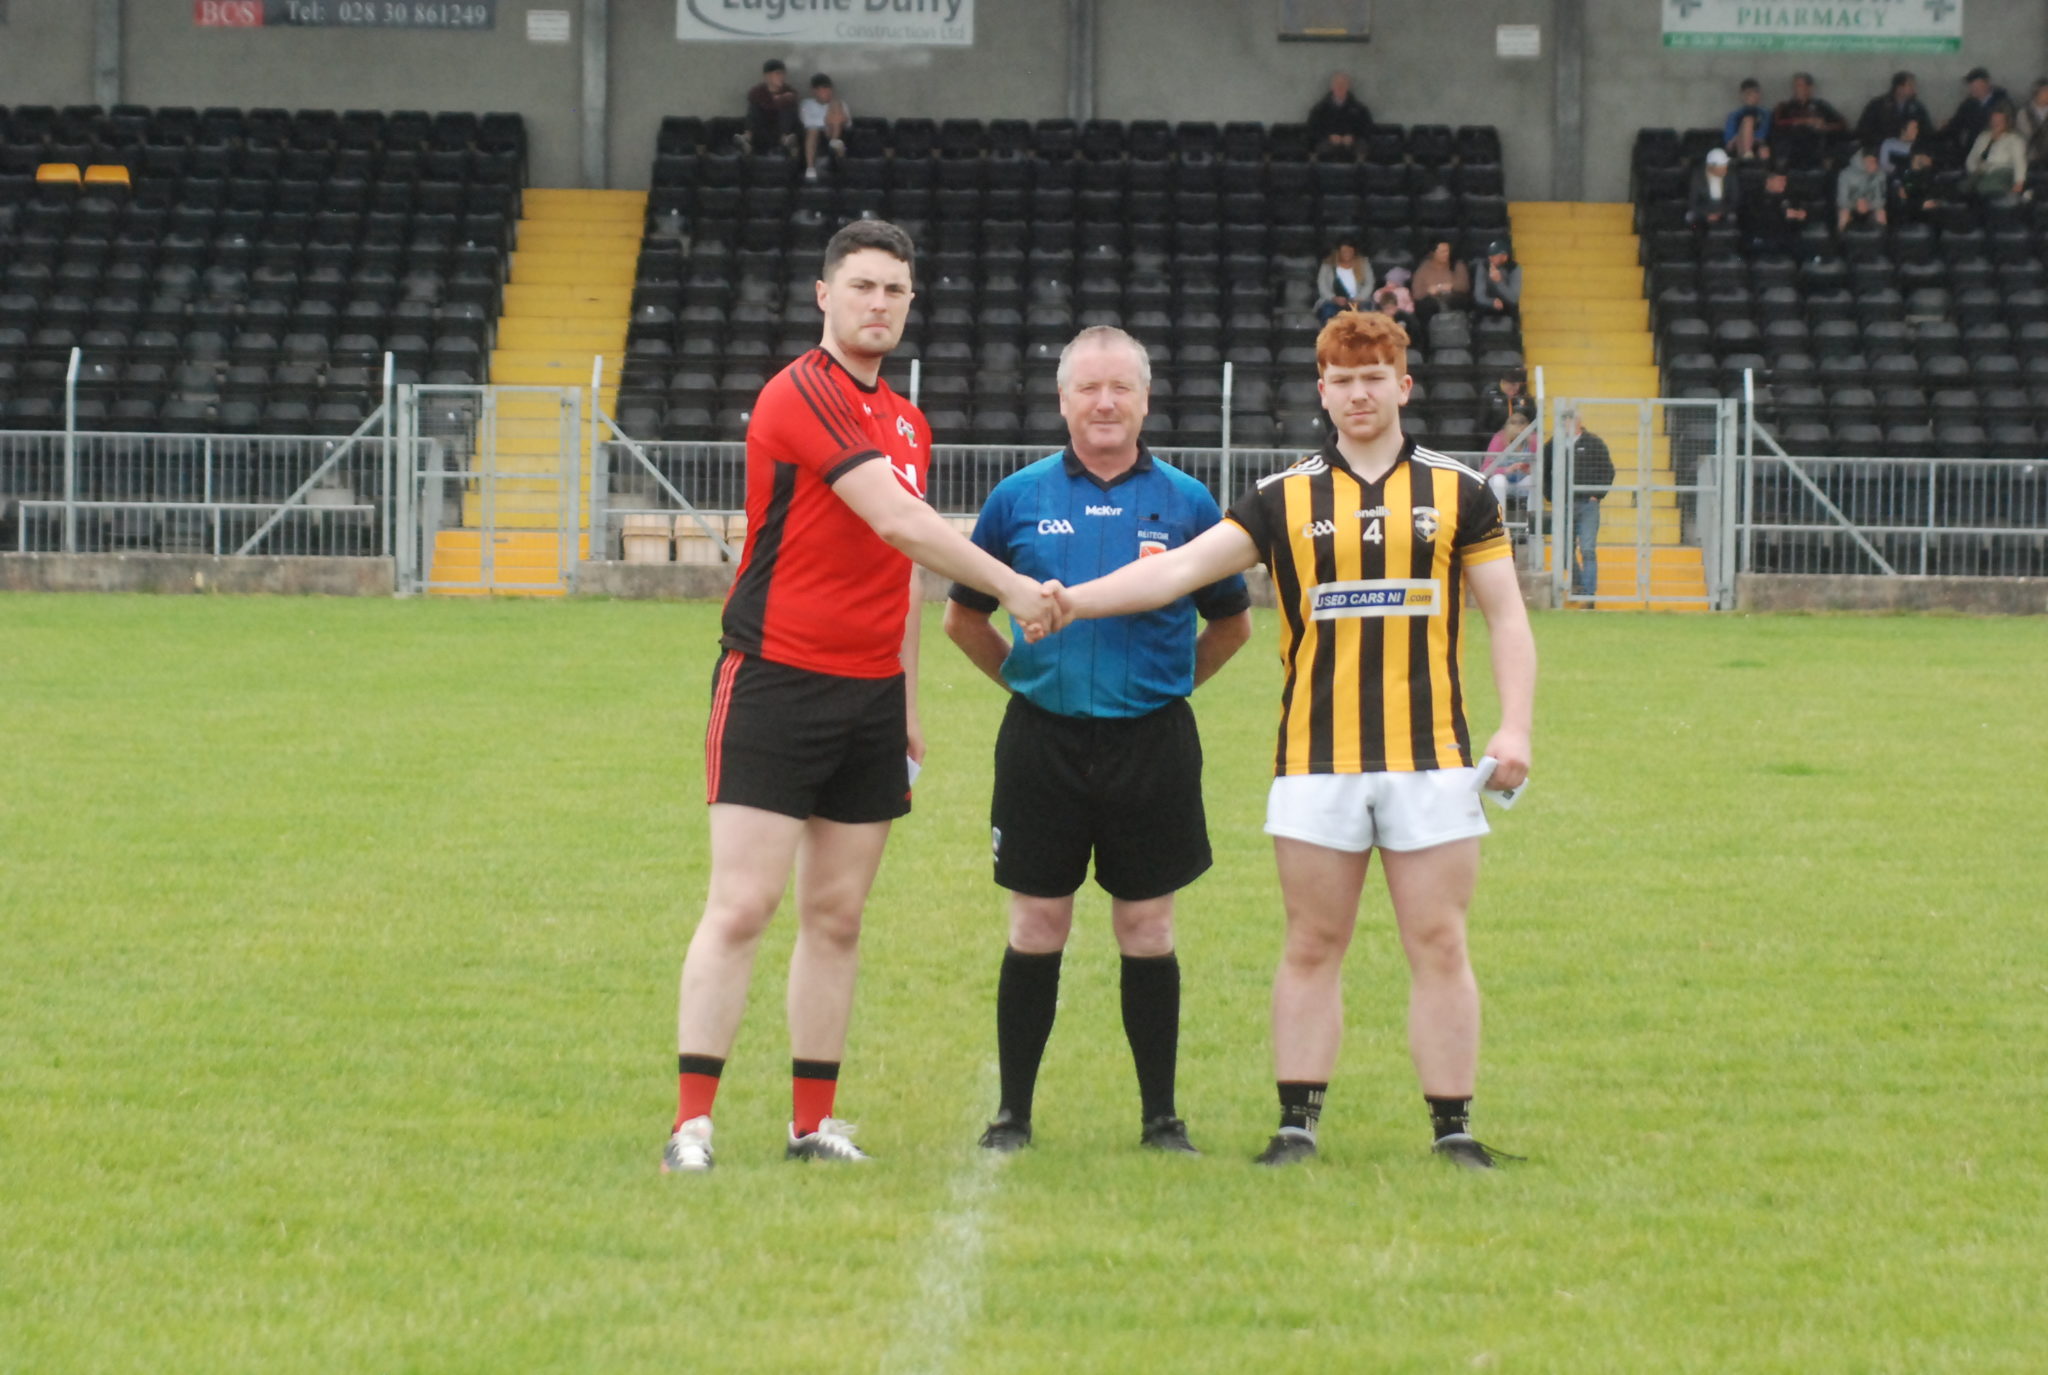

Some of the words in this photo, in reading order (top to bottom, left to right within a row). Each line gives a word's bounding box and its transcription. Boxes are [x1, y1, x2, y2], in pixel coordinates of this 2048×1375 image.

[202, 0, 256, 25] BCS
[286, 0, 326, 20] Tel:
[339, 1, 376, 21] 028
[384, 3, 407, 22] 30
[413, 4, 487, 24] 861249
[1737, 7, 1887, 27] PHARMACY
[836, 22, 938, 39] Construction
[942, 23, 966, 40] Ltd
[1363, 518, 1383, 544] 4
[1350, 592, 1386, 604] CARS
